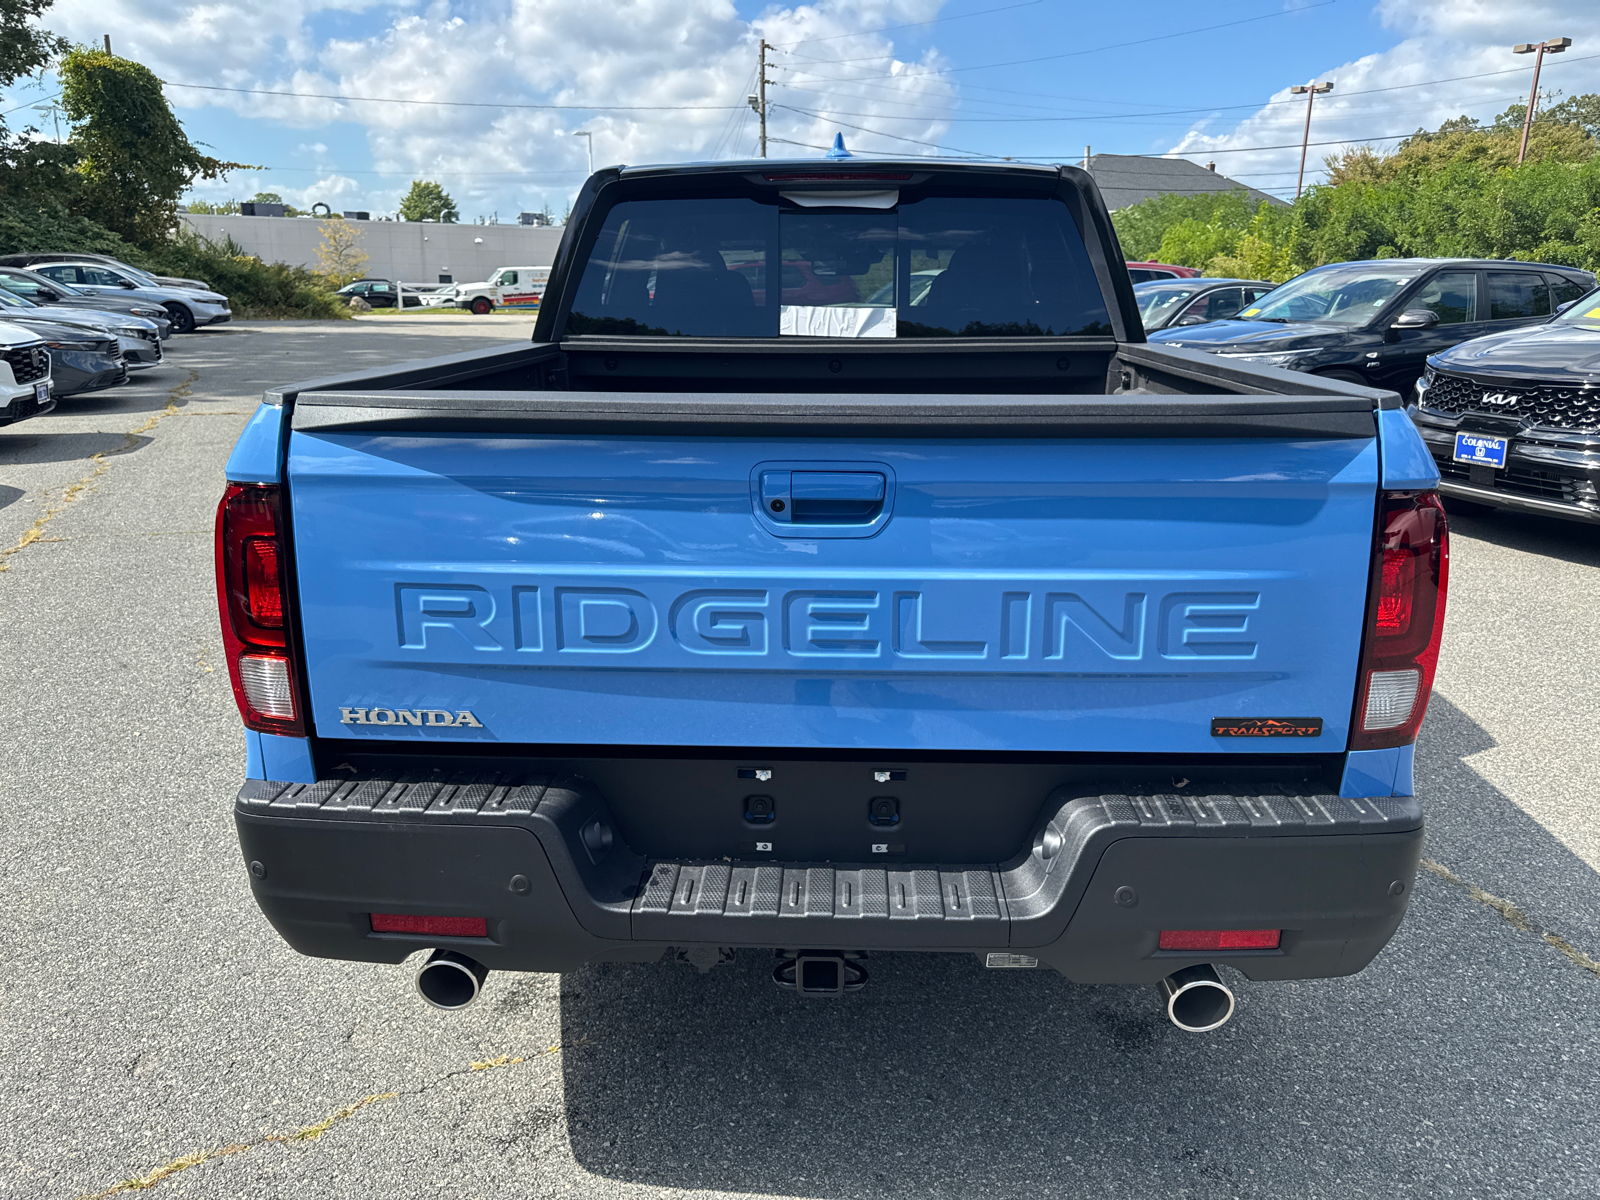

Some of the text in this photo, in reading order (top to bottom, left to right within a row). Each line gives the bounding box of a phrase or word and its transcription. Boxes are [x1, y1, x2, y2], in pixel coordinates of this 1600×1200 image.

[1482, 392, 1518, 406] KIA
[1462, 435, 1501, 450] COLONIAL
[394, 582, 1261, 661] RIDGELINE
[338, 706, 484, 728] HONDA
[1215, 727, 1319, 736] TRAILSPORT
